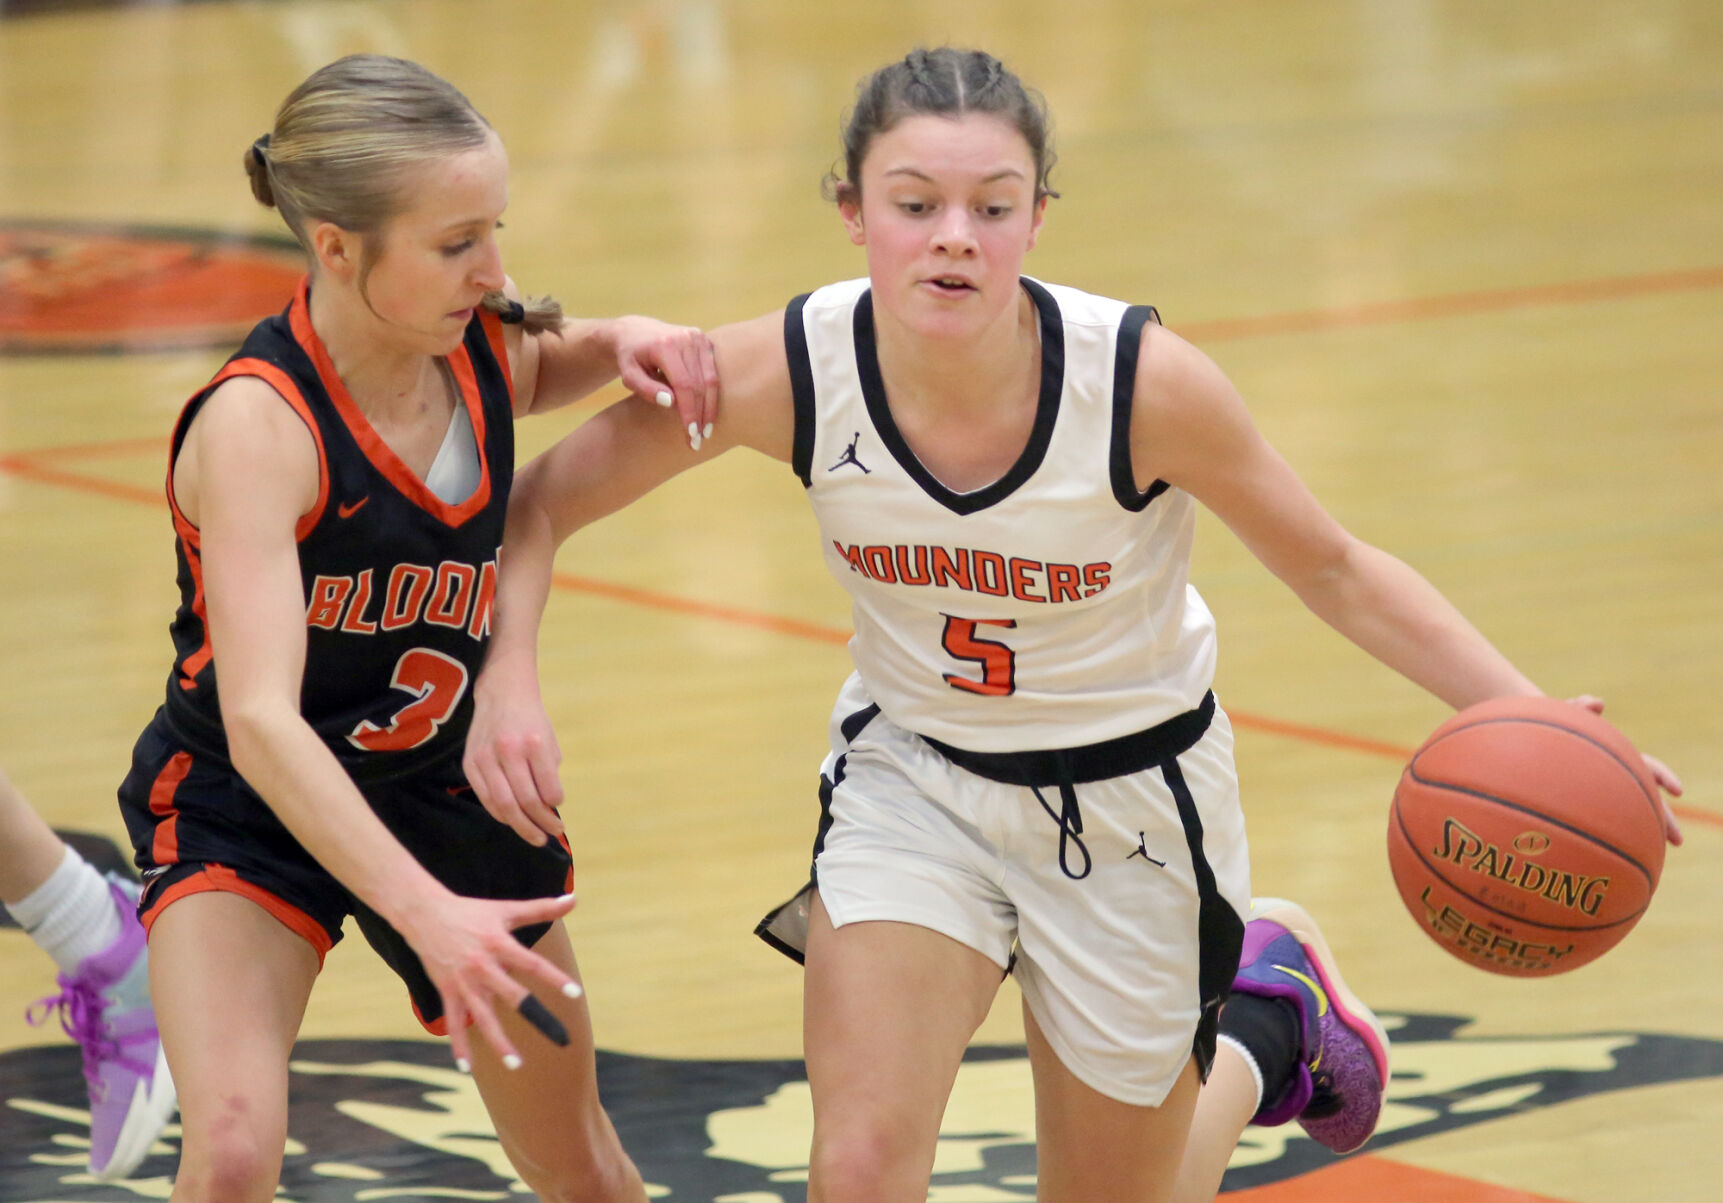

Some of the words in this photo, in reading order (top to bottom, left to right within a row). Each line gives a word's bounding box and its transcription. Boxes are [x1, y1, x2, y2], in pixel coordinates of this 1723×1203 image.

[833, 539, 1112, 603] MOUNDERS
[939, 611, 1017, 696] 5
[345, 647, 468, 751] 3
[1433, 817, 1610, 917] SPALDING
[1420, 885, 1574, 960] LEGACY
